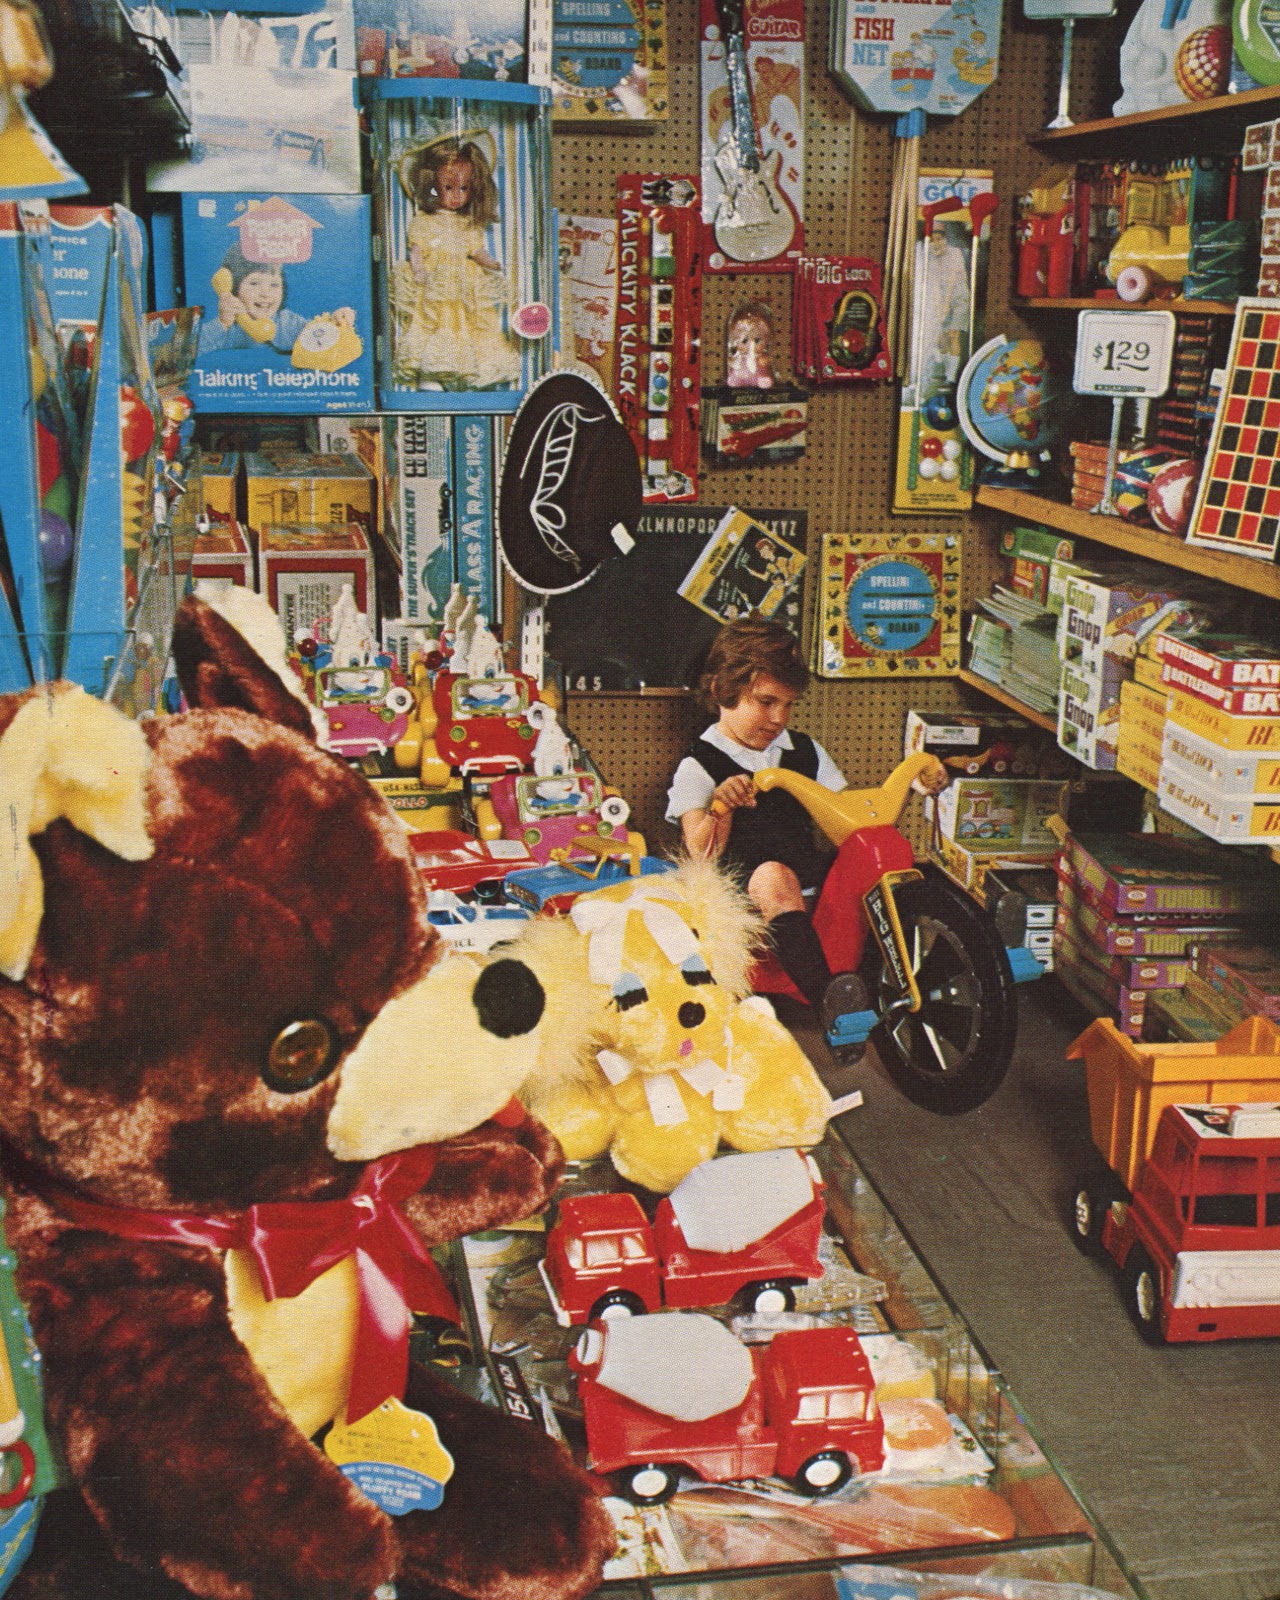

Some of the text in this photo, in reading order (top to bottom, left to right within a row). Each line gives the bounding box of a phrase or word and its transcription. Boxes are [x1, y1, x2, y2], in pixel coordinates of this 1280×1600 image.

[562, 2, 611, 17] SPELLING
[573, 30, 627, 44] COUNTING
[854, 17, 895, 41] FISH
[852, 43, 889, 66] NET
[816, 265, 842, 284] BIG
[618, 208, 639, 397] KLICKITY KLACK
[263, 369, 360, 389] Telephone
[464, 424, 485, 515] RACING
[405, 488, 416, 509] SET
[406, 561, 418, 596] SUPER
[407, 599, 418, 618] THE
[1068, 607, 1101, 650] Gnop
[1065, 693, 1095, 737] Gnop
[872, 898, 889, 935] BIG
